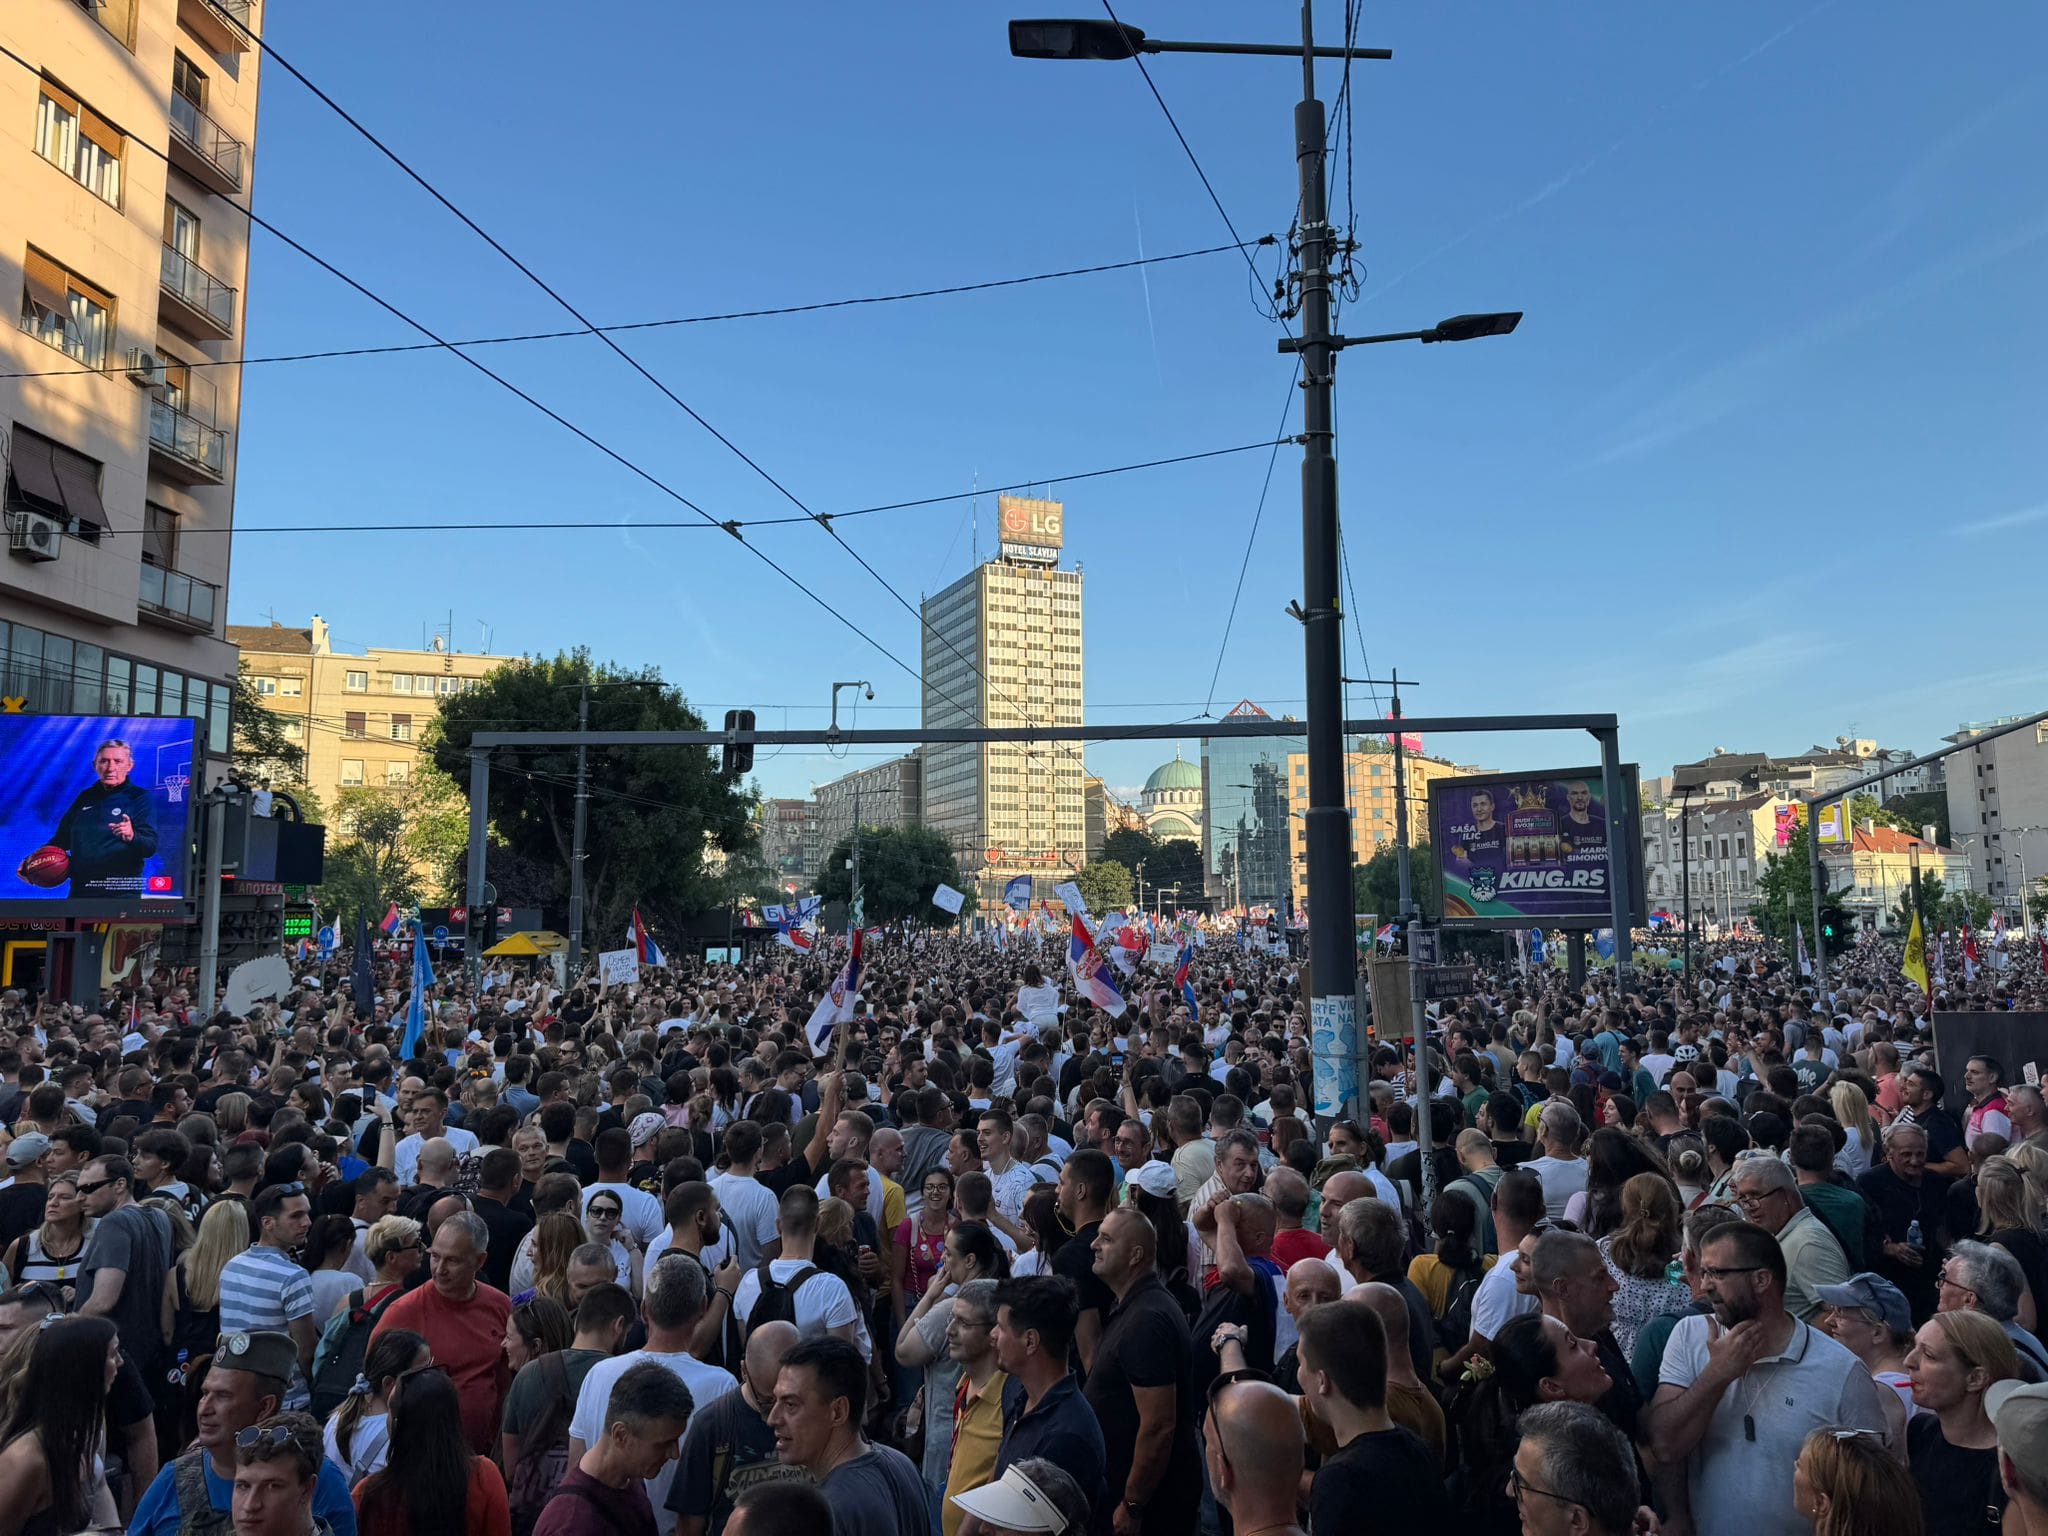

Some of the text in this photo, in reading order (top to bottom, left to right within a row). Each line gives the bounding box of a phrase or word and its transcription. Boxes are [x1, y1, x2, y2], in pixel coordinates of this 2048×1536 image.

[1032, 513, 1060, 534] LG
[1003, 543, 1058, 559] HOTEL SLAVIJA
[1450, 823, 1477, 834] SAŠA
[1499, 869, 1605, 889] KING.RS
[238, 883, 284, 895] АПОТЕКА
[285, 919, 311, 927] 117.00
[284, 927, 311, 935] 117.50
